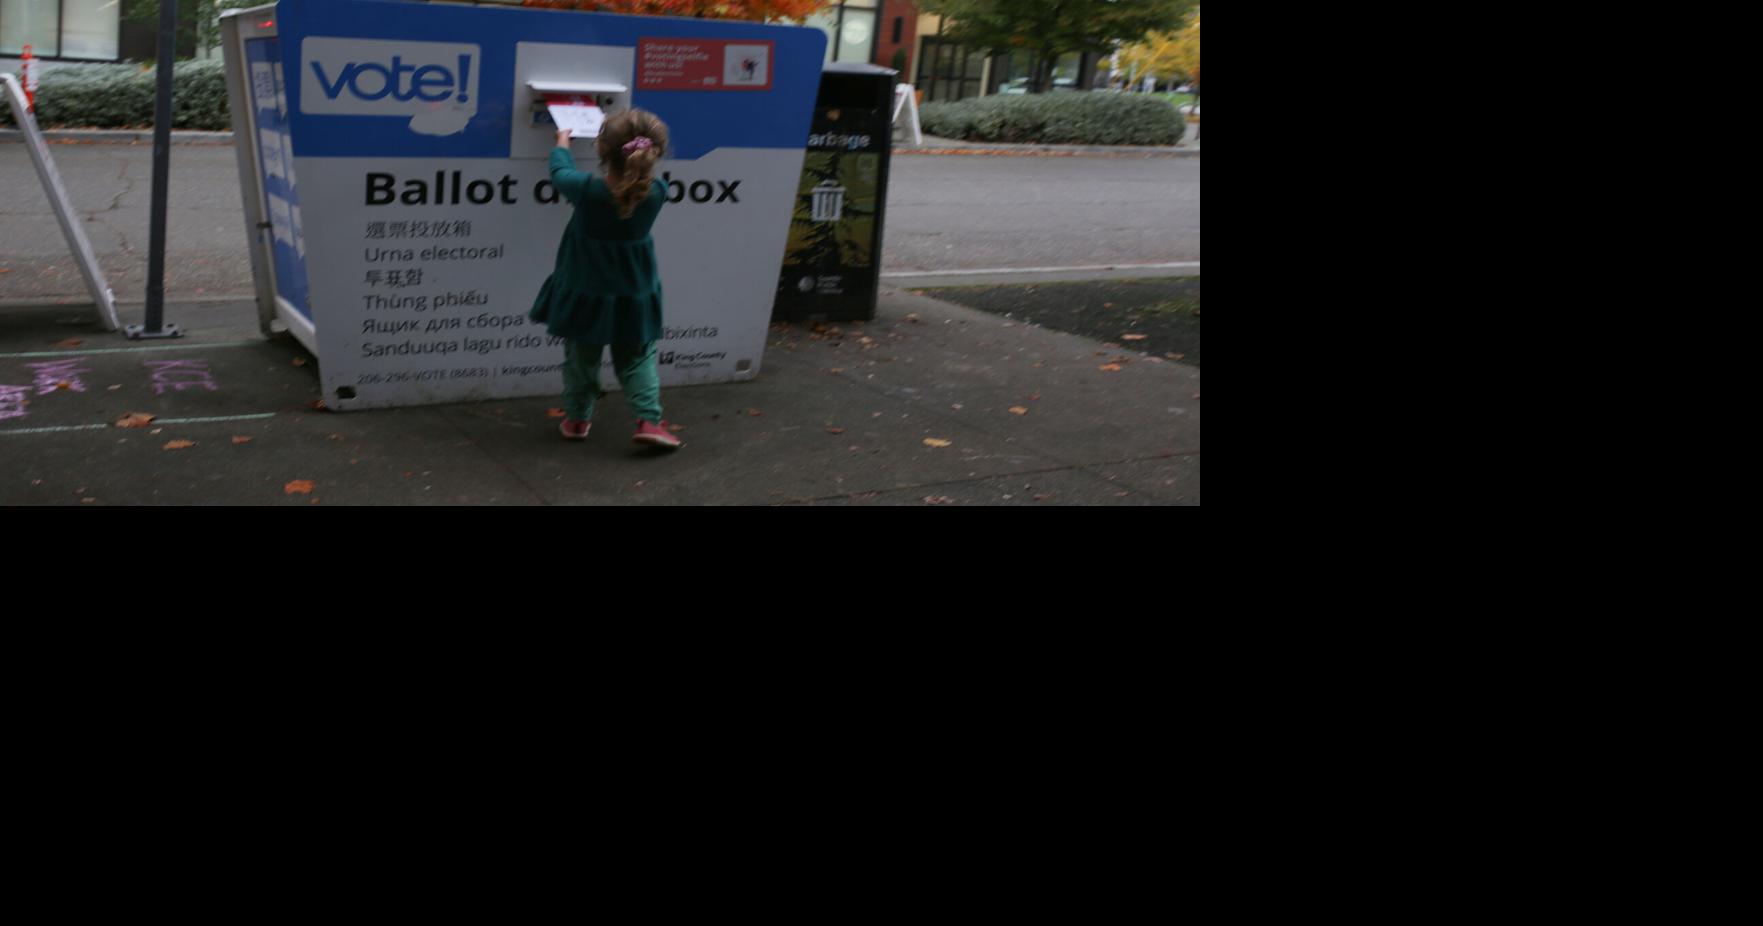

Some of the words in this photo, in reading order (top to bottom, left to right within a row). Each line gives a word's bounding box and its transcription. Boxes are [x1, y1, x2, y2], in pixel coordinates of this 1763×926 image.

[310, 54, 471, 103] vote!
[807, 130, 873, 150] arbage
[365, 170, 518, 206] Ballot
[662, 171, 741, 204] box
[364, 247, 414, 263] Urna
[420, 243, 504, 262] electoral
[363, 292, 428, 312] Thùng
[433, 289, 489, 311] phiếu
[361, 318, 420, 335] Ящик
[425, 317, 461, 334] для
[466, 312, 525, 331] сбора
[662, 325, 719, 341] bixinta
[361, 340, 458, 358] Sanduuqa
[463, 337, 501, 354] lagu
[506, 333, 542, 350] rido
